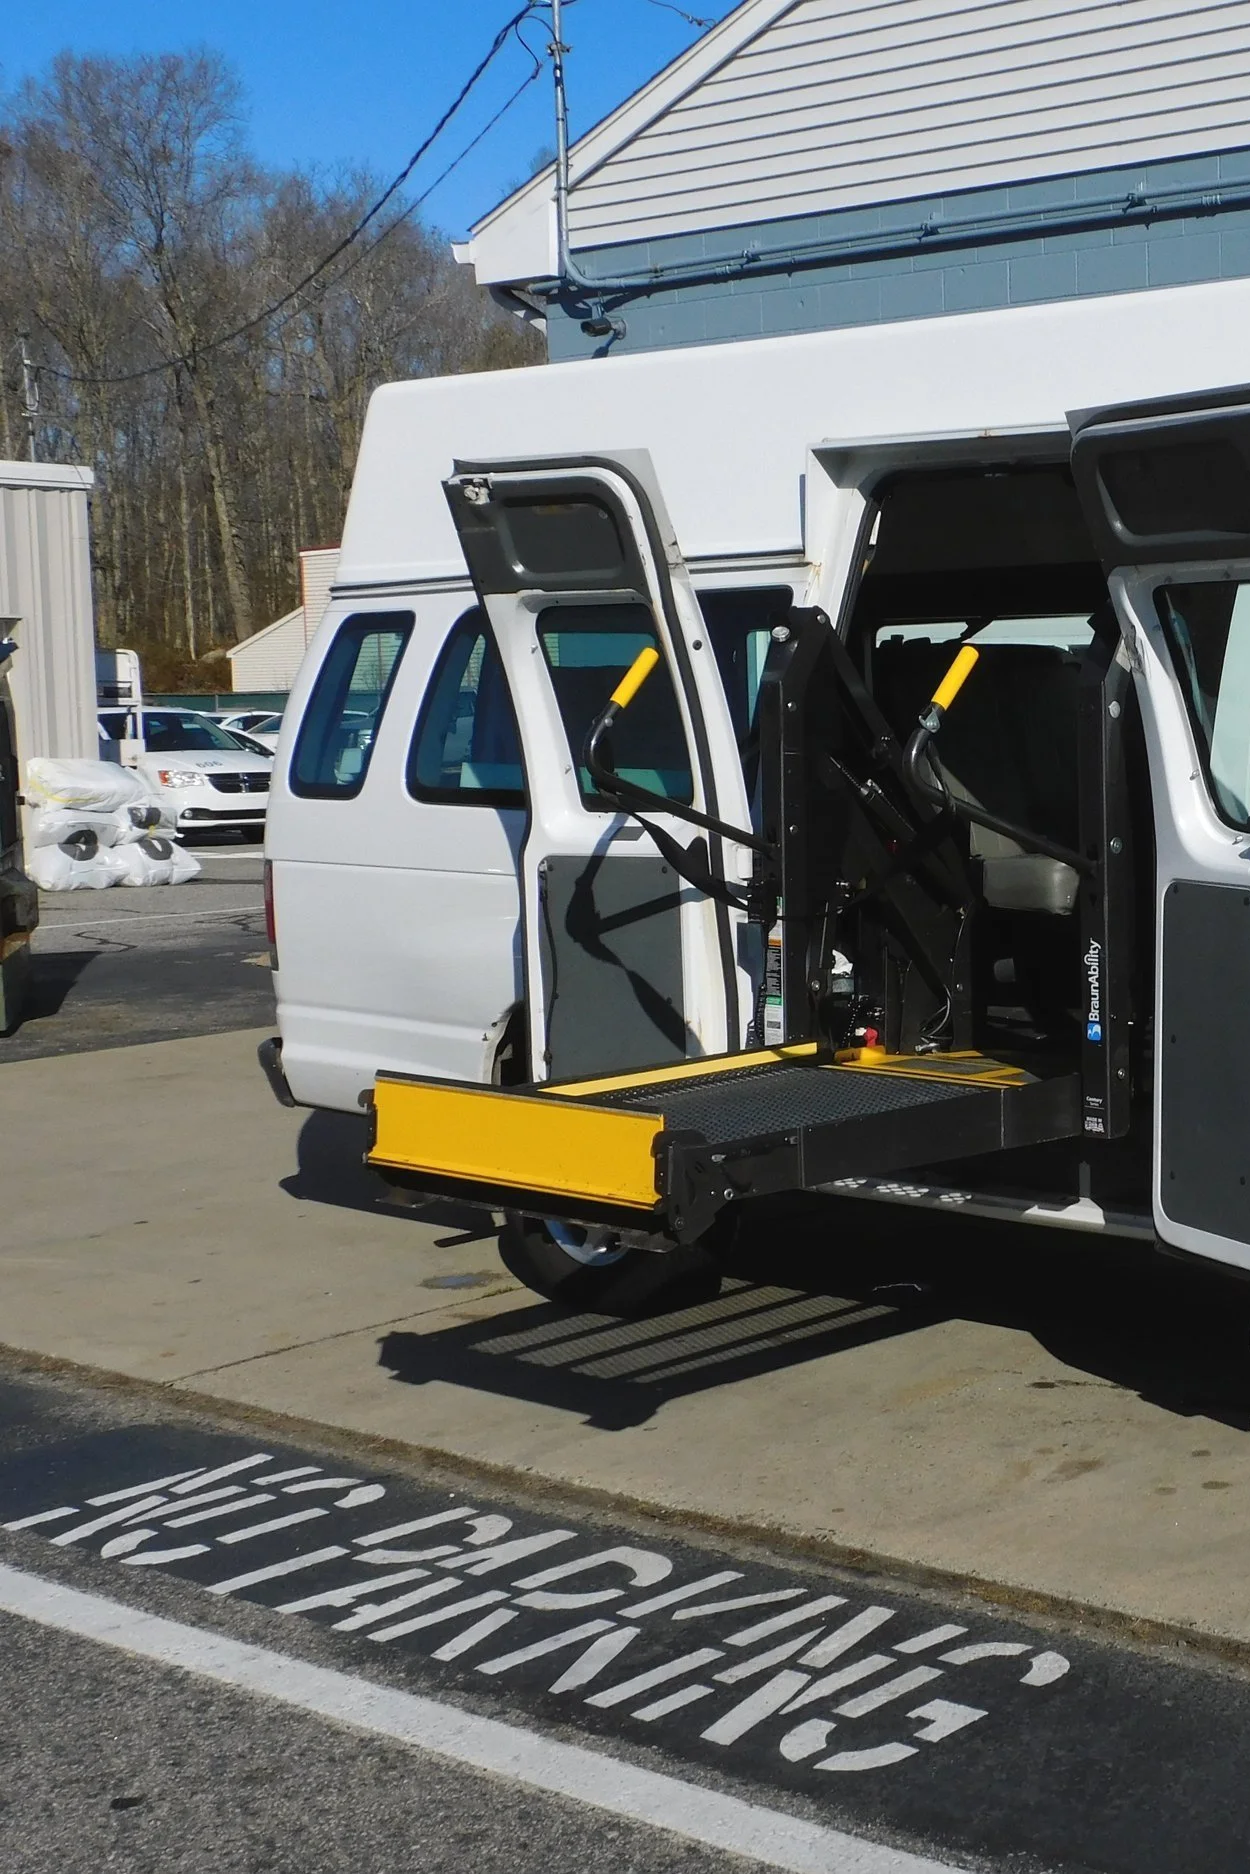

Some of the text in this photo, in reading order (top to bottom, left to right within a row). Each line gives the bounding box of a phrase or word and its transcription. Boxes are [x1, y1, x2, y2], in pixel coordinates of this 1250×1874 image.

[1083, 937, 1102, 1022] BraunAbility
[2, 1453, 1070, 1771] NO PARKING
